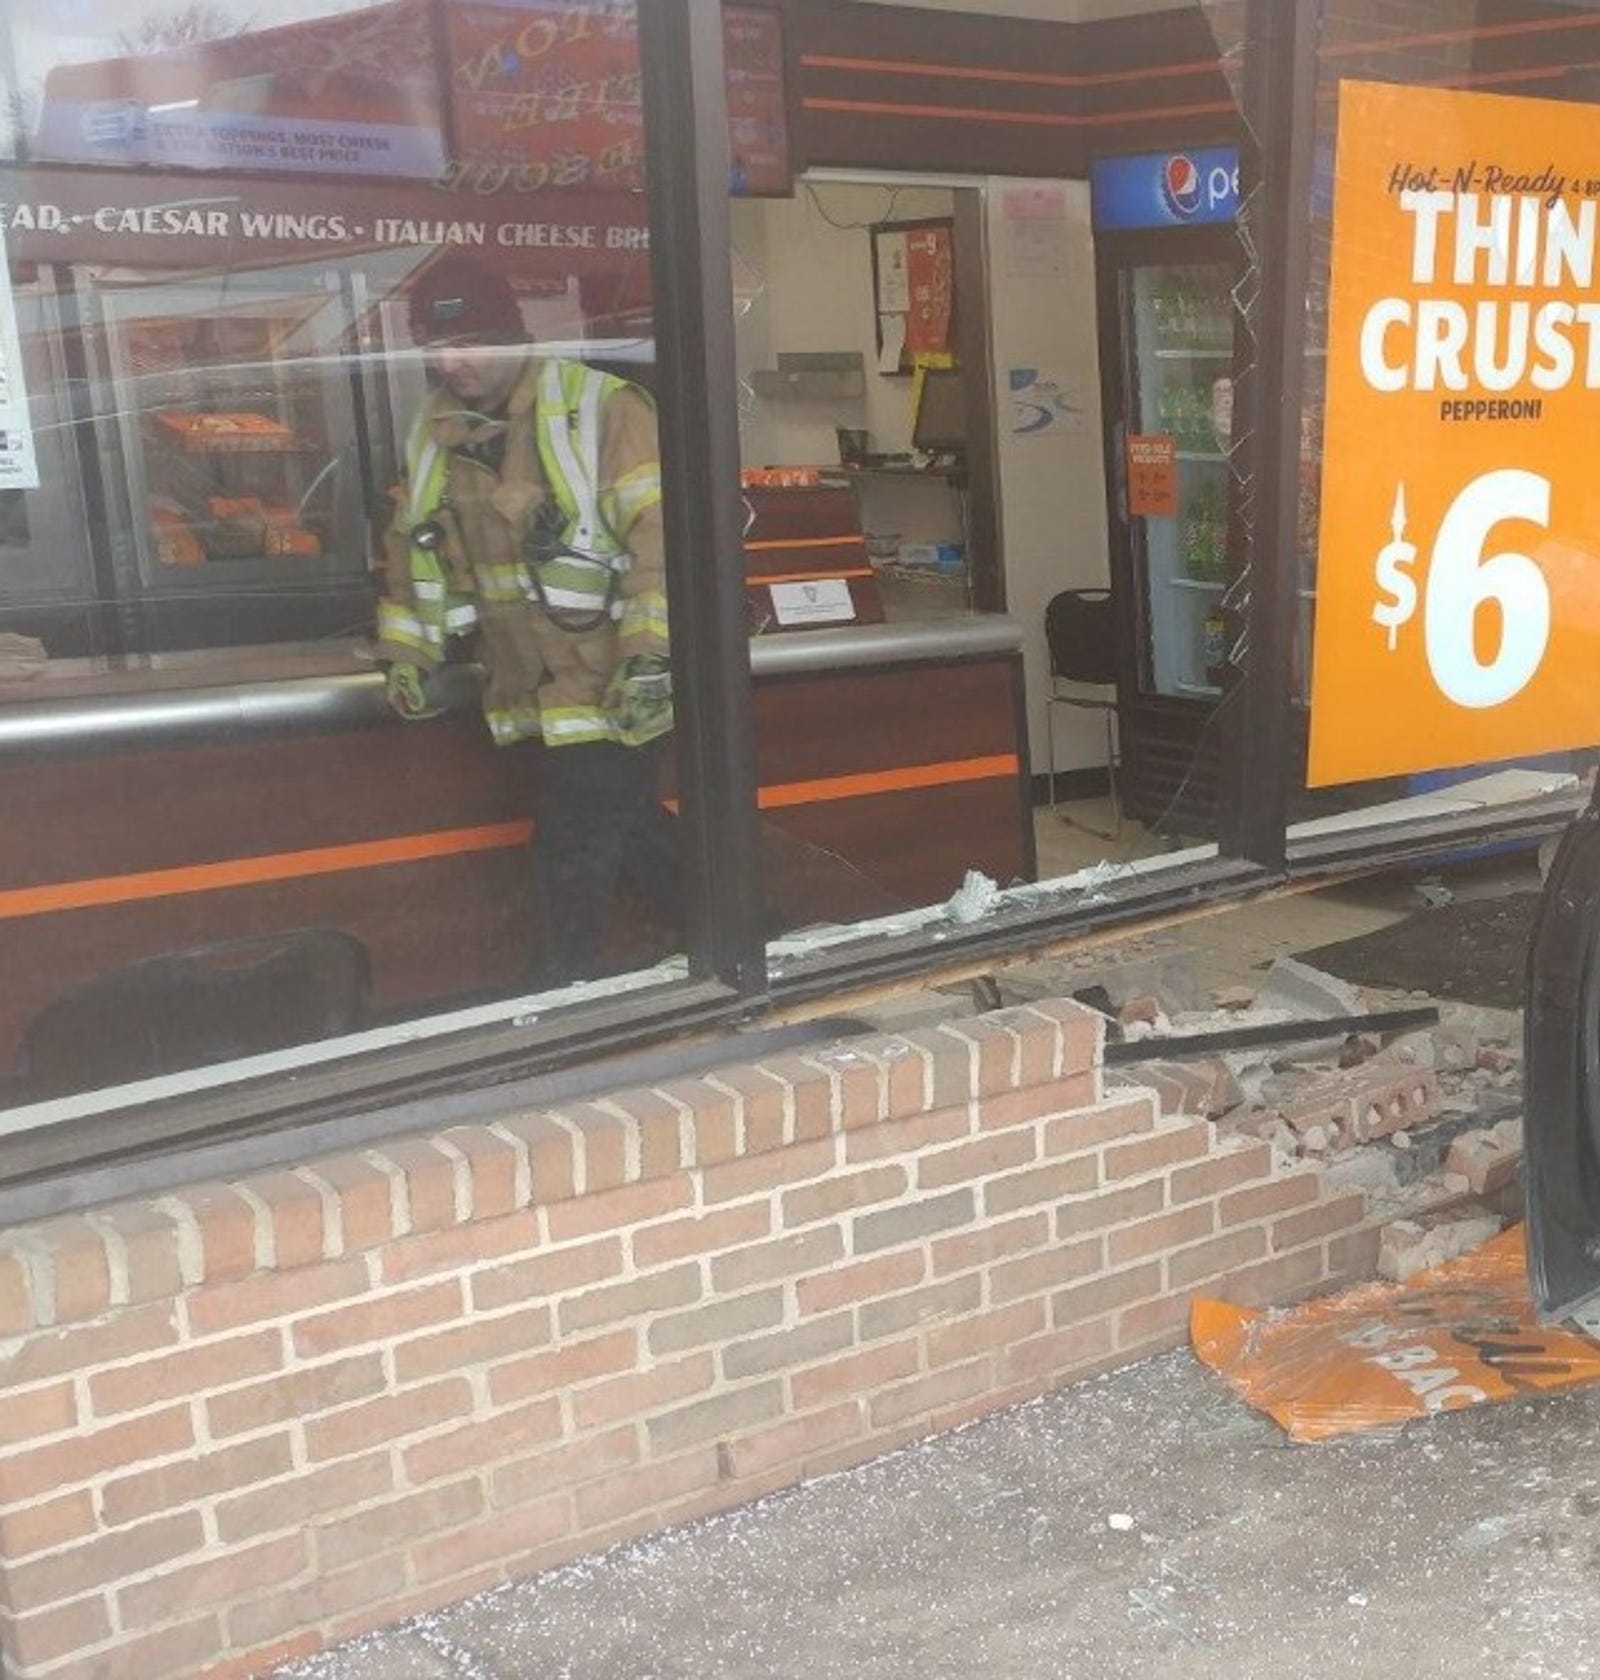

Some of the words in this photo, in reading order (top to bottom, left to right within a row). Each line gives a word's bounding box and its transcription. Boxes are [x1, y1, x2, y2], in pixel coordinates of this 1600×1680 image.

[1388, 160, 1565, 209] Hot-N-Ready
[94, 207, 229, 236] CAESAR
[374, 219, 485, 245] ITALIAN
[497, 223, 597, 248] CHEESE
[1400, 189, 1598, 289] THIN
[1440, 399, 1542, 422] PEPPERONI
